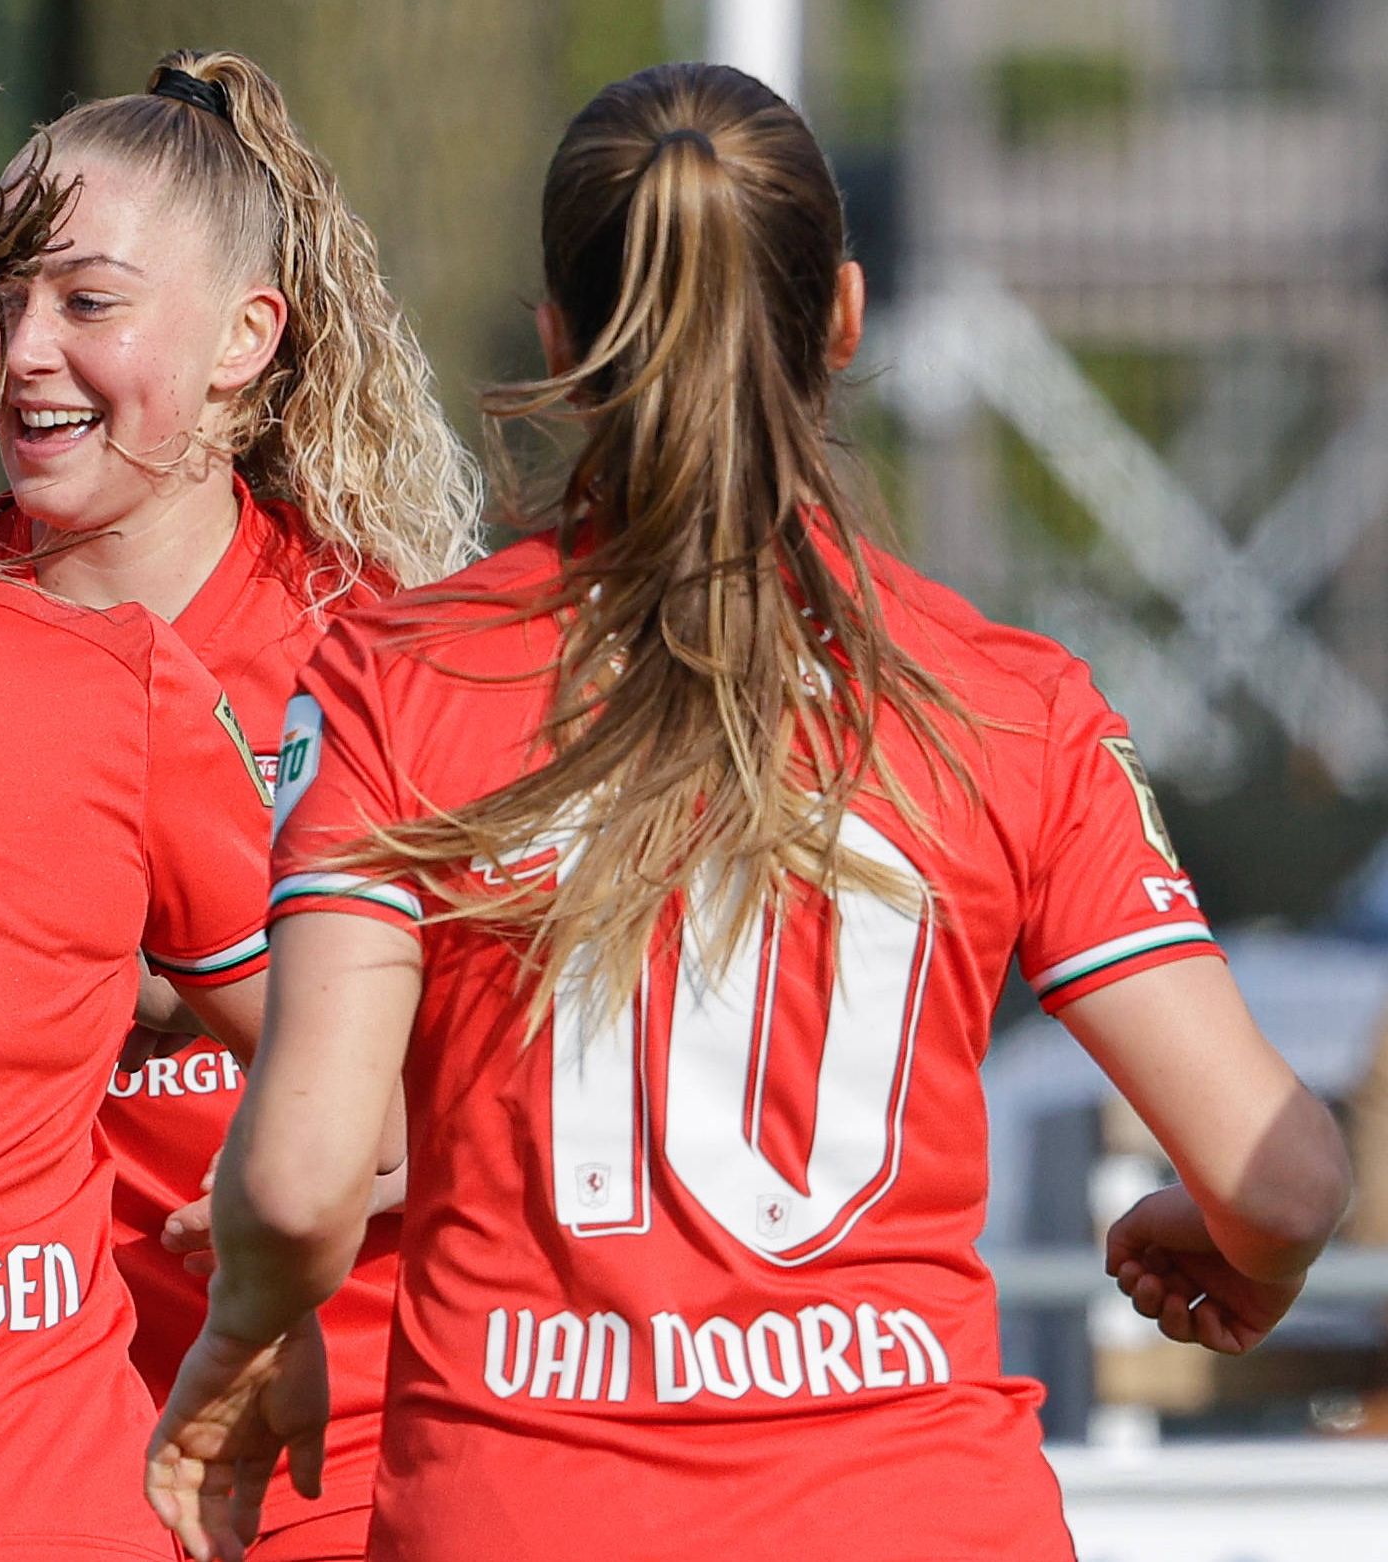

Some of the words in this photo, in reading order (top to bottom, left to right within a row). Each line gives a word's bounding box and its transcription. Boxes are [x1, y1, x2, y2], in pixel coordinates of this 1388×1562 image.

[470, 784, 935, 1269] 10
[484, 1307, 631, 1402] VAN
[650, 1302, 950, 1403] DOOREN
